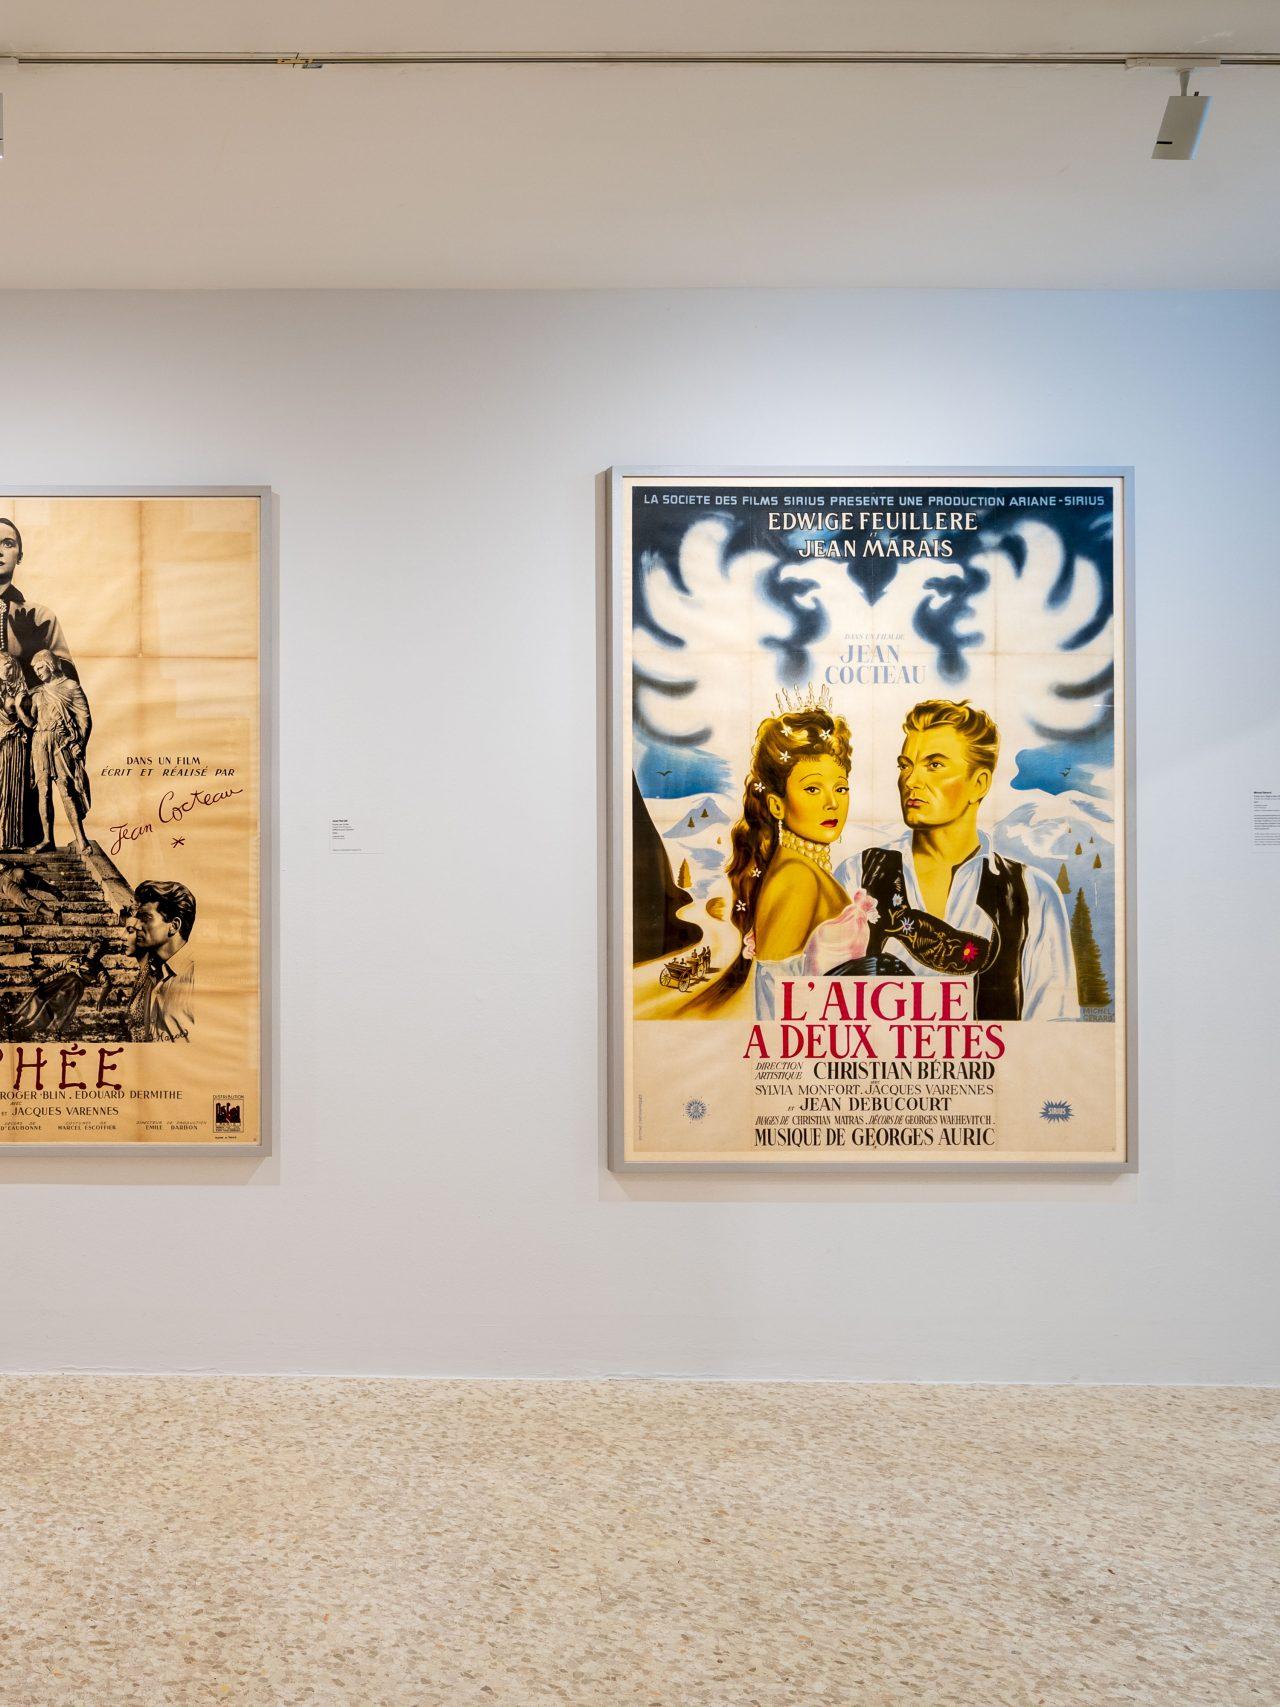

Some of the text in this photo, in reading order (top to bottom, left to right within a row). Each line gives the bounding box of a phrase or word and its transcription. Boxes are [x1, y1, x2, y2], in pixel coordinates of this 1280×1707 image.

[644, 494, 659, 504] LA
[662, 494, 711, 505] SOCIETE
[715, 495, 737, 505] DES
[742, 496, 779, 506] FILMS
[784, 496, 825, 506] SIRIUS
[830, 496, 894, 506] PRESENTE
[899, 496, 923, 506] UNE
[929, 496, 1005, 506] PRODUCTION
[768, 512, 978, 531] EDWIGE FEUILLERE
[798, 540, 953, 558] JEAN MARAIS
[840, 645, 900, 663] JEAN
[825, 665, 927, 684] COCTEAU
[126, 757, 201, 765] DANS UN FILM
[101, 766, 235, 776] ÉCRIT ET RÉALISÉ PAR
[110, 788, 244, 855] Jean Cocteau
[781, 981, 968, 1021] L'AIGLE
[743, 1024, 1006, 1060] A DEUX TETES
[755, 1059, 995, 1079] DIRECTION CHRISTIAN BÉRARD
[755, 1071, 802, 1080] ARTISTIQUE
[0, 1091, 37, 1099] ROGER
[75, 1091, 125, 1099] EDOUARD
[130, 1090, 183, 1099] DERMITHE
[755, 1085, 793, 1095] SYLVIA
[865, 1084, 922, 1095] JACQUES
[925, 1084, 994, 1095] VARENNES
[12, 1107, 62, 1117] JACQUES
[66, 1107, 119, 1116] VARENNES
[799, 1097, 841, 1111] JEAN
[849, 1097, 952, 1111] DEBUCOURT
[755, 1116, 779, 1125] IMAGES
[780, 1116, 790, 1125] DE
[792, 1116, 831, 1125] CHRISTIAN
[894, 1116, 903, 1125] DE
[905, 1116, 938, 1125] GEORGES
[755, 1128, 995, 1147] MUSIQUE DE GEORGES AURIC
